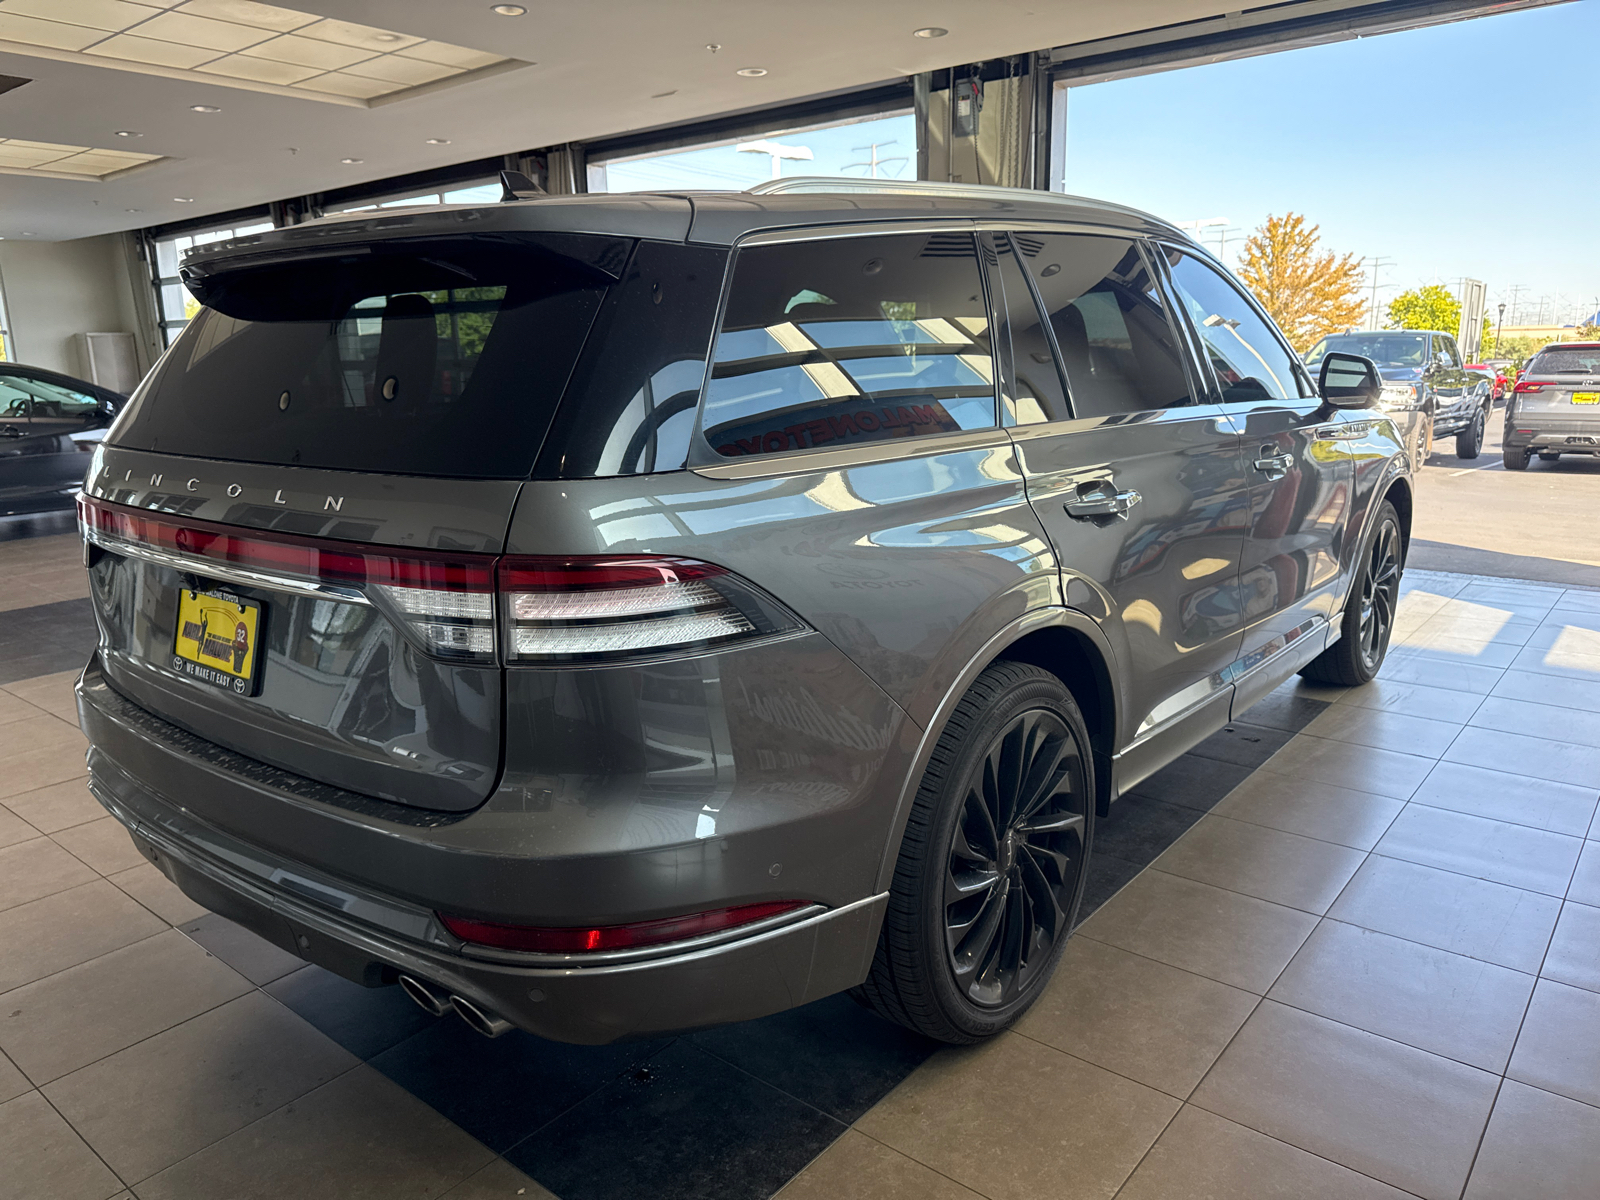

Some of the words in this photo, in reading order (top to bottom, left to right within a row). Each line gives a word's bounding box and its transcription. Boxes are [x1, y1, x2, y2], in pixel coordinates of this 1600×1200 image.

[103, 466, 345, 513] LINCOLN
[223, 592, 239, 604] TOYOTA
[236, 628, 246, 643] 32
[202, 638, 232, 663] MALONE
[186, 664, 195, 674] WE
[195, 666, 209, 680] MAKE
[209, 671, 216, 682] IT
[216, 673, 231, 687] EASY
